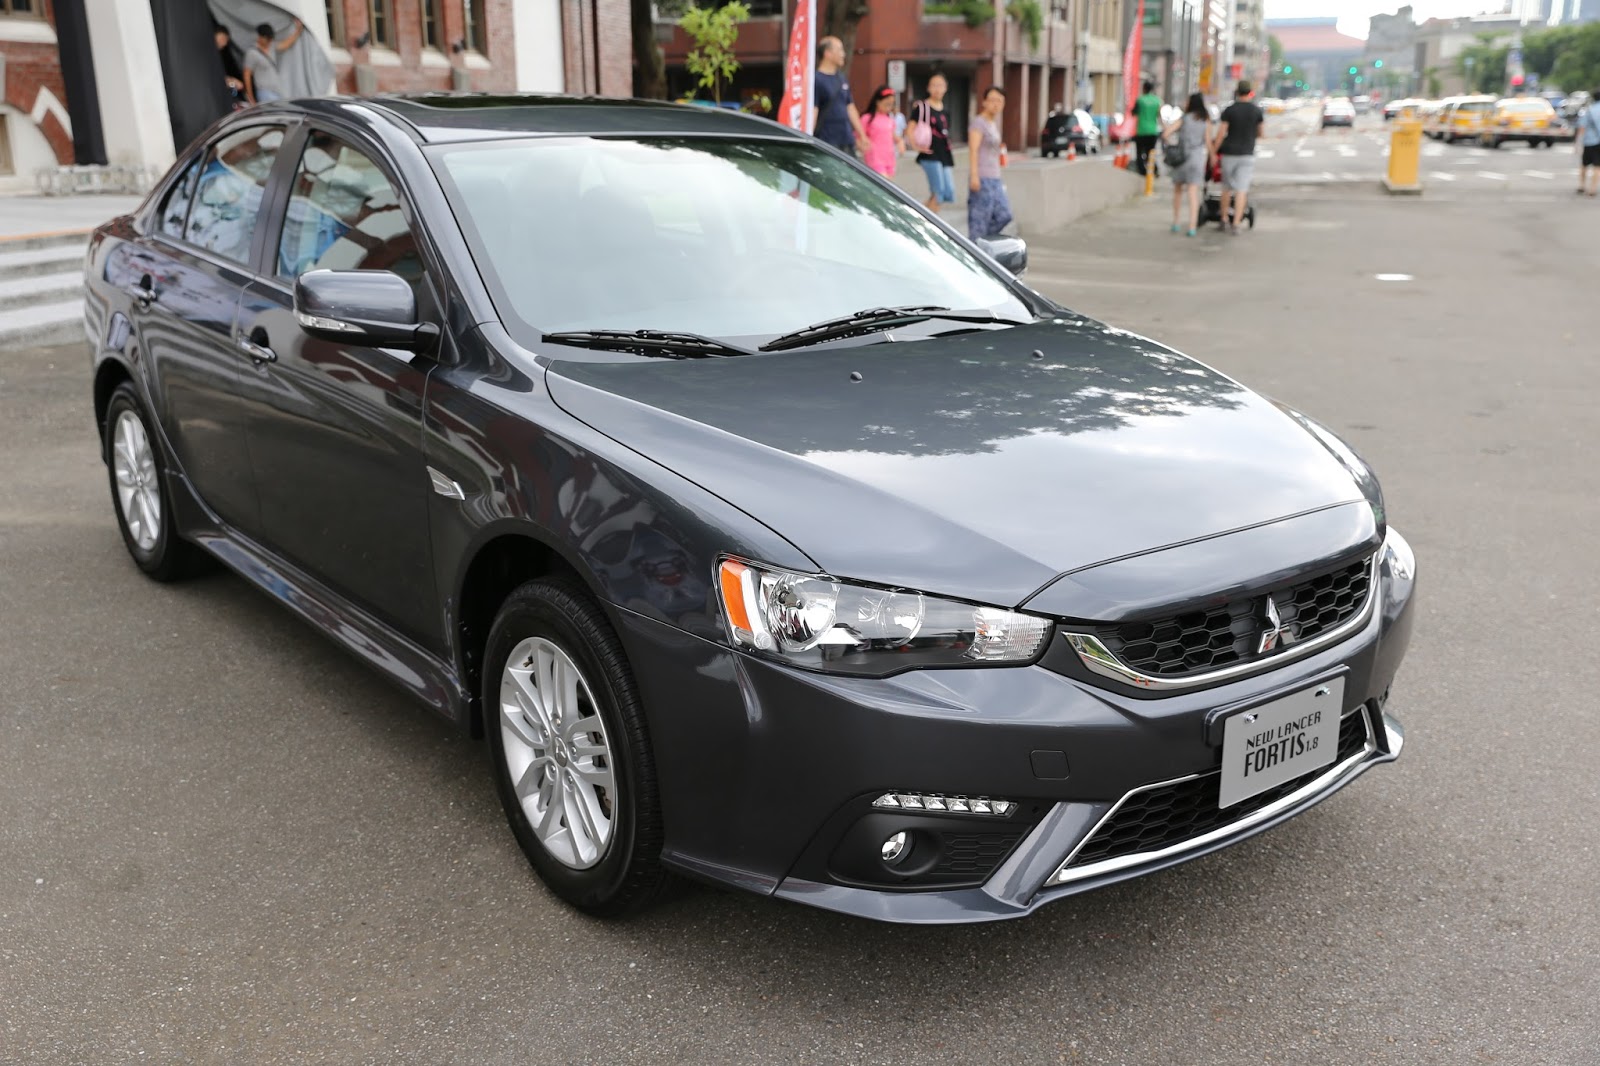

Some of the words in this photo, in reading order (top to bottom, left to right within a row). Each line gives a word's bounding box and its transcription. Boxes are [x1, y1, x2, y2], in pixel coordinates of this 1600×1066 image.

[1246, 729, 1274, 750] NEW
[1277, 711, 1321, 739] LANCER
[1244, 732, 1305, 777] FORTIS
